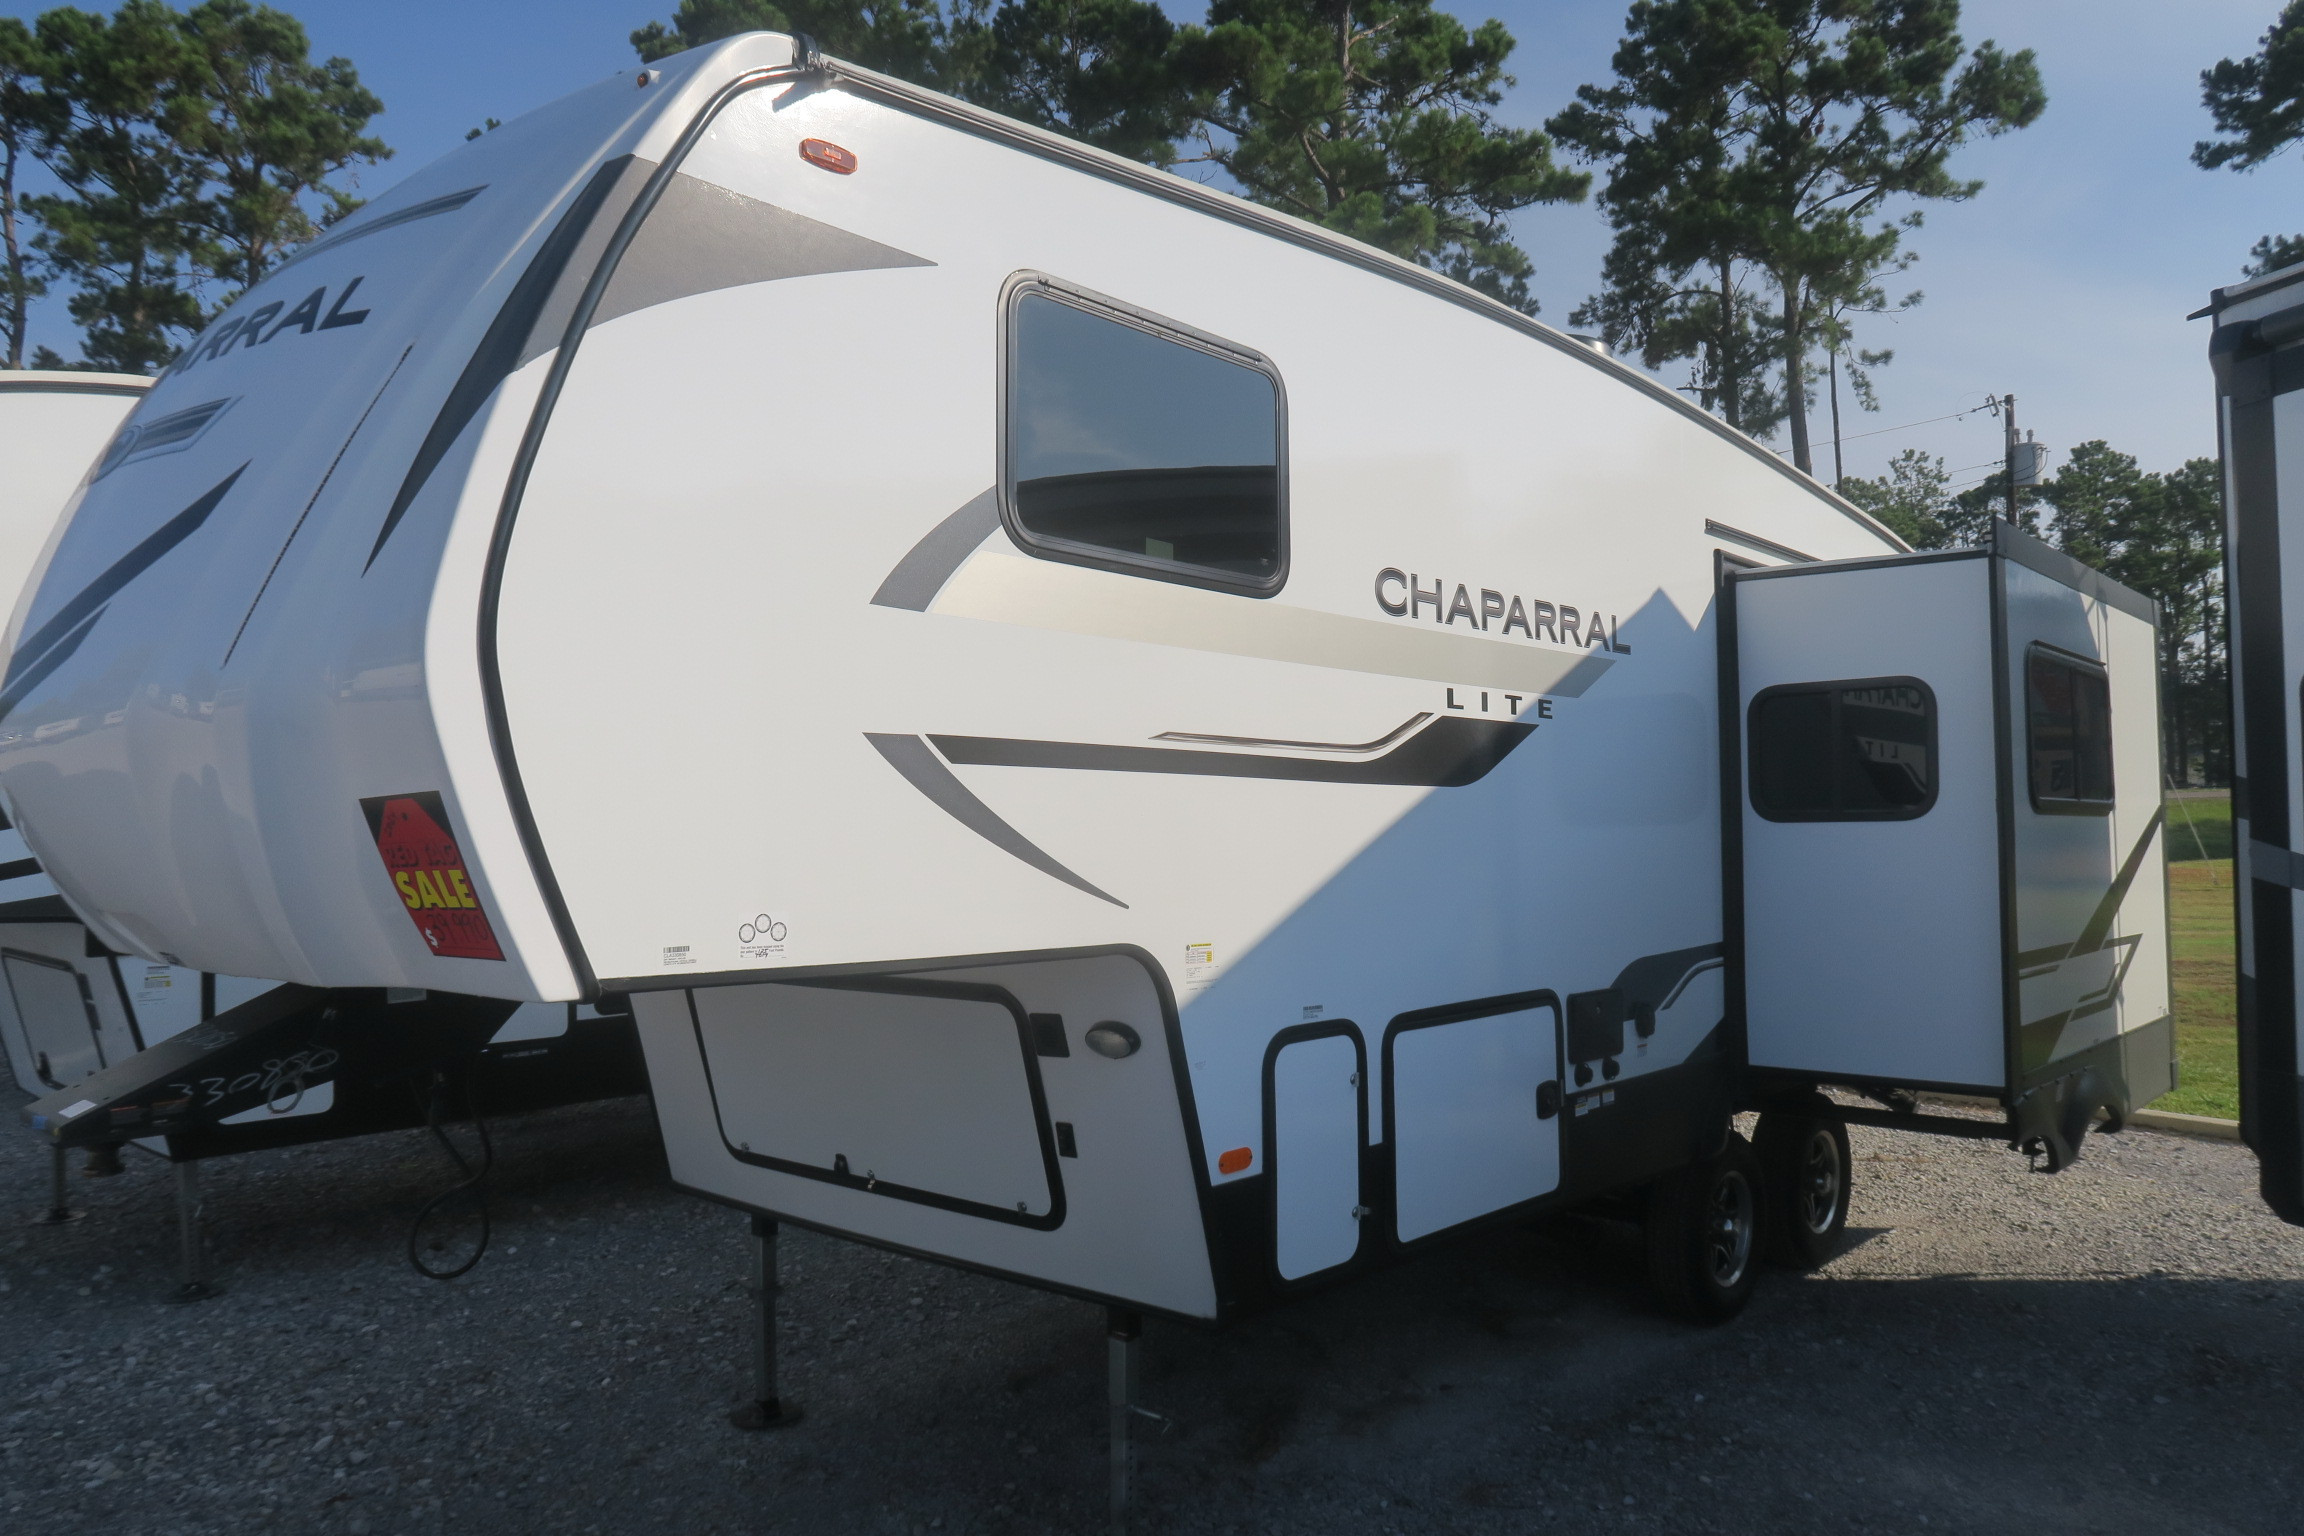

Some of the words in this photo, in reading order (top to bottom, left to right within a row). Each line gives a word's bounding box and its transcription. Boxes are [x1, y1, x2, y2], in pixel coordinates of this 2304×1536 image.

[1374, 566, 1632, 656] CHAPARRAL
[1446, 687, 1555, 720] LITE
[396, 870, 477, 910] SALE
